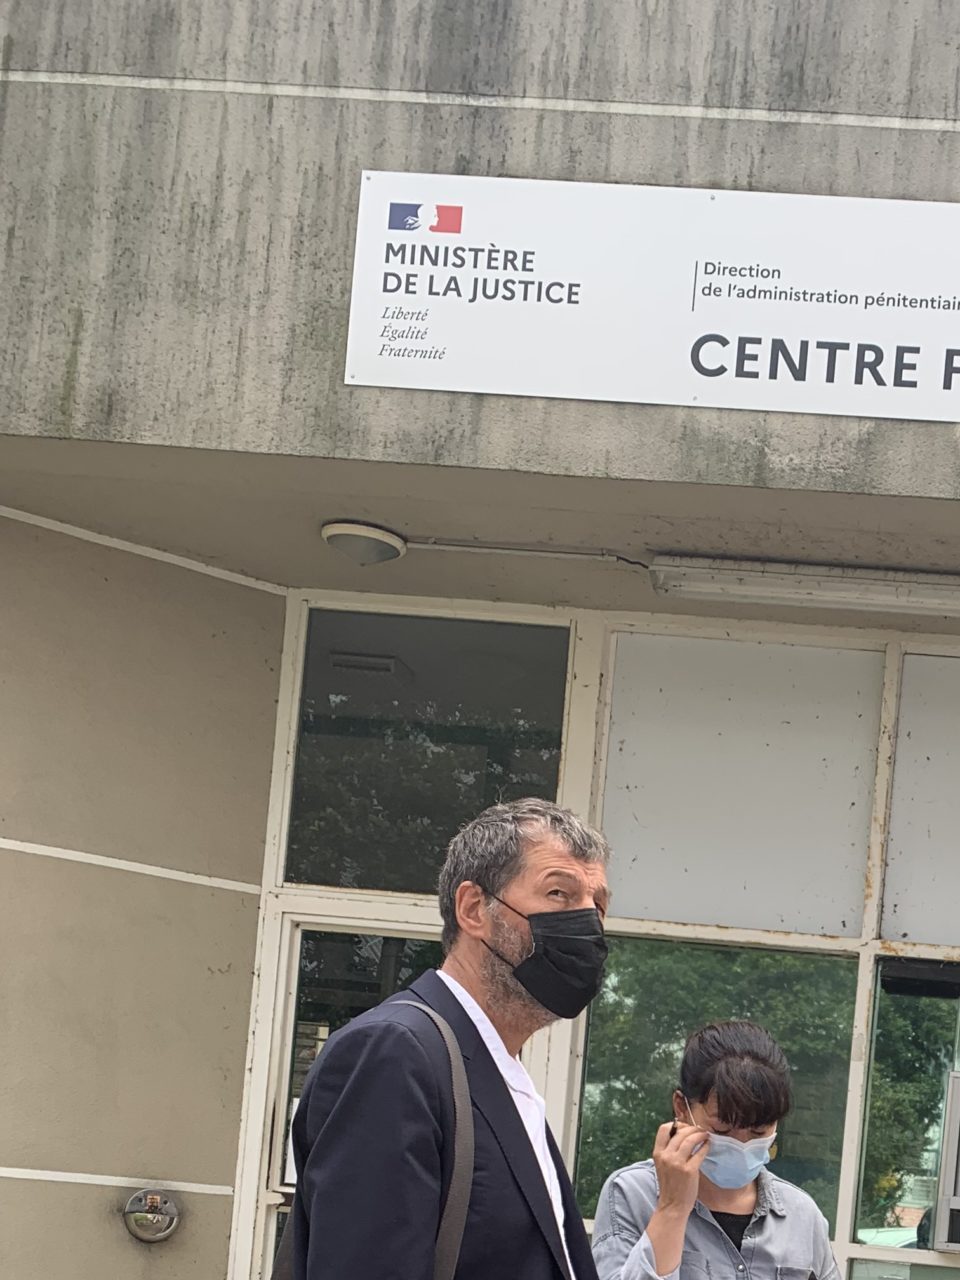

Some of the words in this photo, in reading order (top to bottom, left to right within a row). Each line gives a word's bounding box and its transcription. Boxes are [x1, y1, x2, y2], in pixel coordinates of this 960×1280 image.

[385, 243, 535, 273] MINISTÈRE
[703, 260, 781, 280] Direction
[382, 273, 418, 295] DE
[427, 274, 463, 298] LA
[468, 277, 581, 304] JUSTICE
[701, 281, 723, 298] de
[381, 306, 428, 322] Liberté
[379, 322, 428, 343] Égalité
[378, 343, 446, 361] Fraternité
[690, 333, 921, 389] CENTRE
